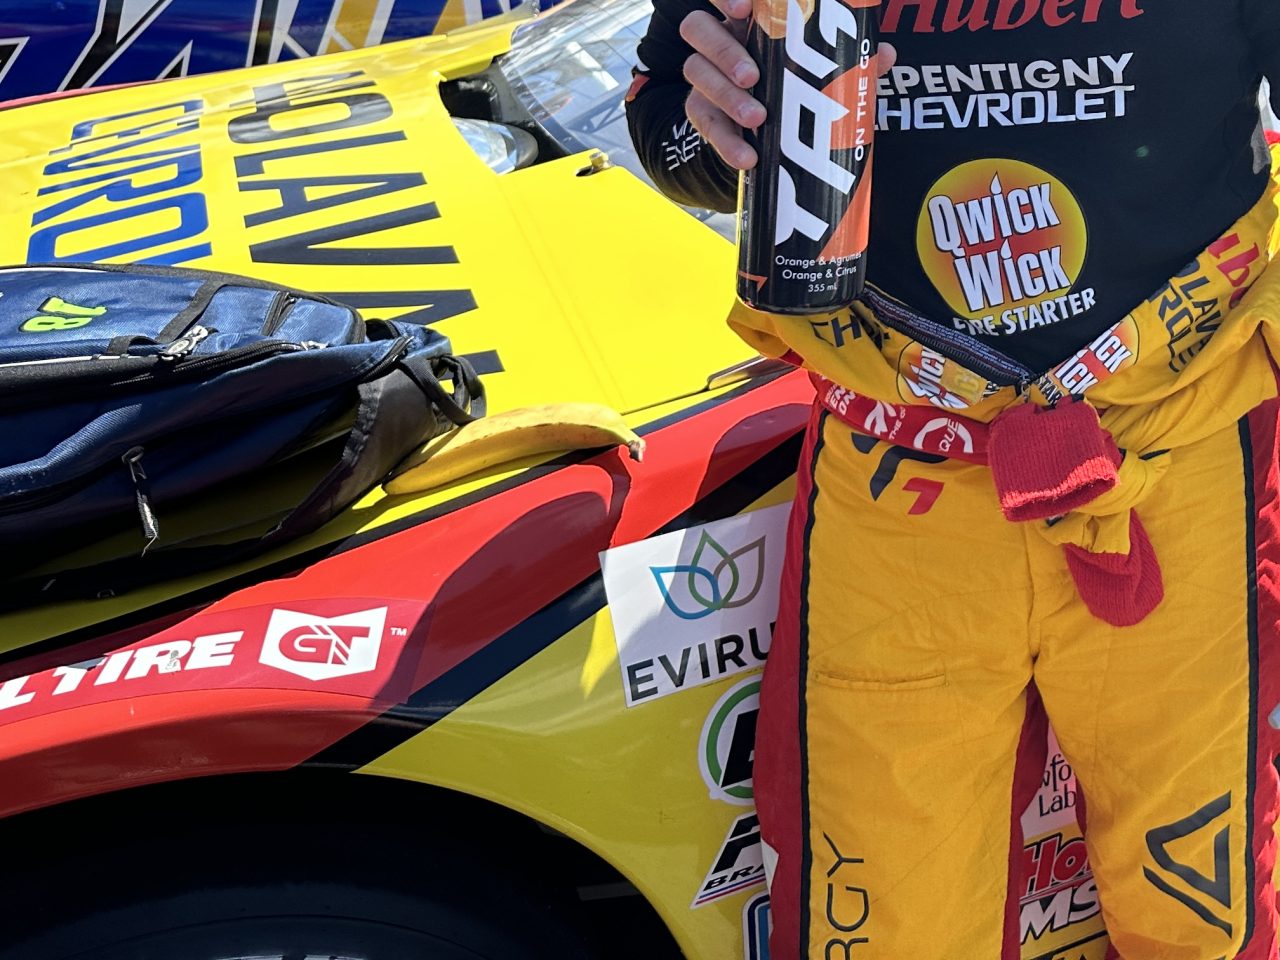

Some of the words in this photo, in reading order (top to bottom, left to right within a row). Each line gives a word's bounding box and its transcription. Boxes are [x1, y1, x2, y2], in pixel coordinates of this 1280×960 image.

[859, 37, 871, 70] GO
[877, 53, 1134, 97] EPENTIGNY
[856, 79, 868, 123] THE
[875, 85, 1135, 131] HEVROLET
[854, 128, 865, 162] ON
[775, 255, 817, 268] Orange
[818, 256, 827, 266] &
[829, 250, 862, 267] Agrumes
[782, 270, 823, 281] Orange
[825, 268, 834, 278] &
[835, 264, 857, 278] Citrus
[808, 283, 825, 293] 355
[1001, 287, 1096, 335] STARTER
[52, 631, 245, 696] TIRE
